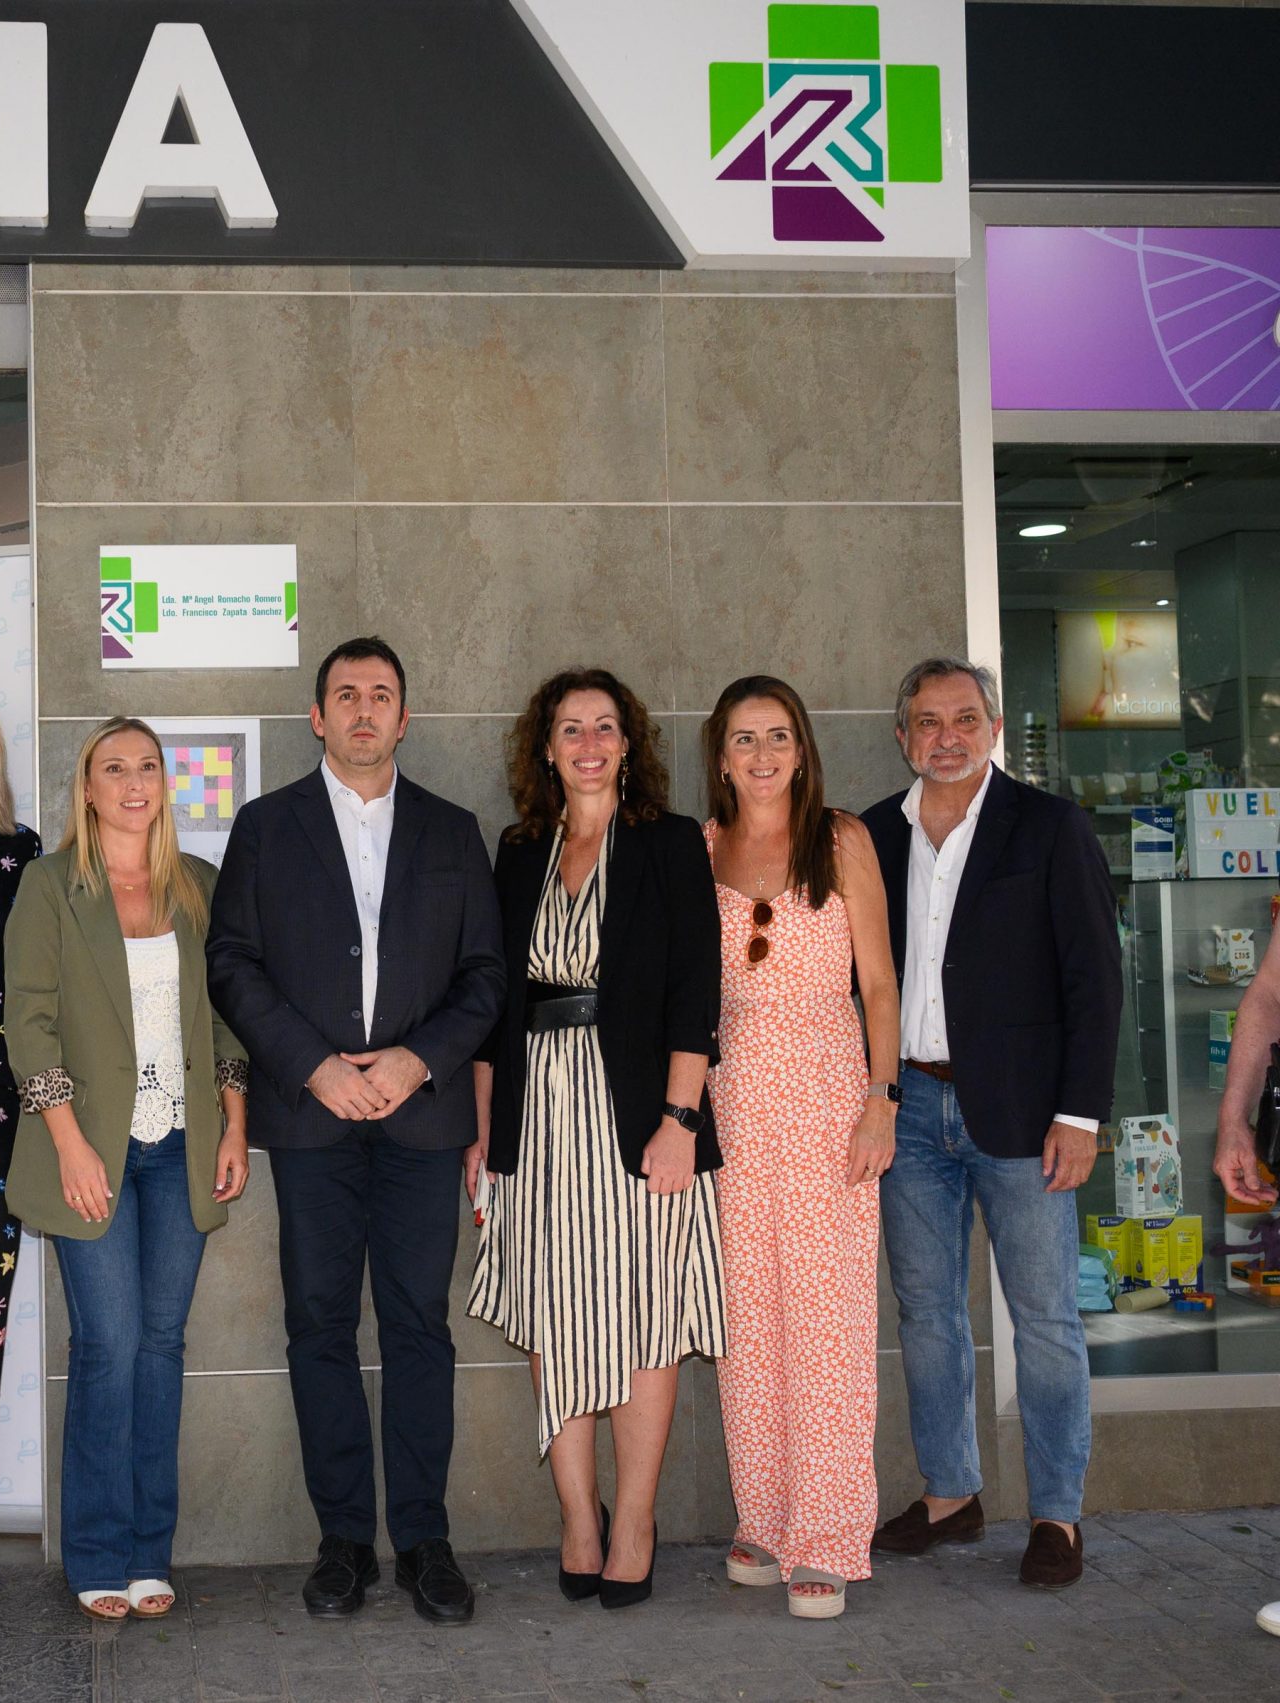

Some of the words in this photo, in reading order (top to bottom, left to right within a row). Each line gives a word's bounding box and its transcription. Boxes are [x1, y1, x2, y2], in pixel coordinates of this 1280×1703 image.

[162, 595, 177, 604] Lda.
[194, 595, 214, 605] Angel
[217, 594, 251, 604] Romacho
[254, 594, 282, 603] Romero
[162, 608, 178, 617] Ldo.
[182, 608, 218, 617] Francisco
[222, 608, 248, 618] Zapata
[252, 607, 282, 616] Sanchez
[1222, 850, 1280, 874] COL
